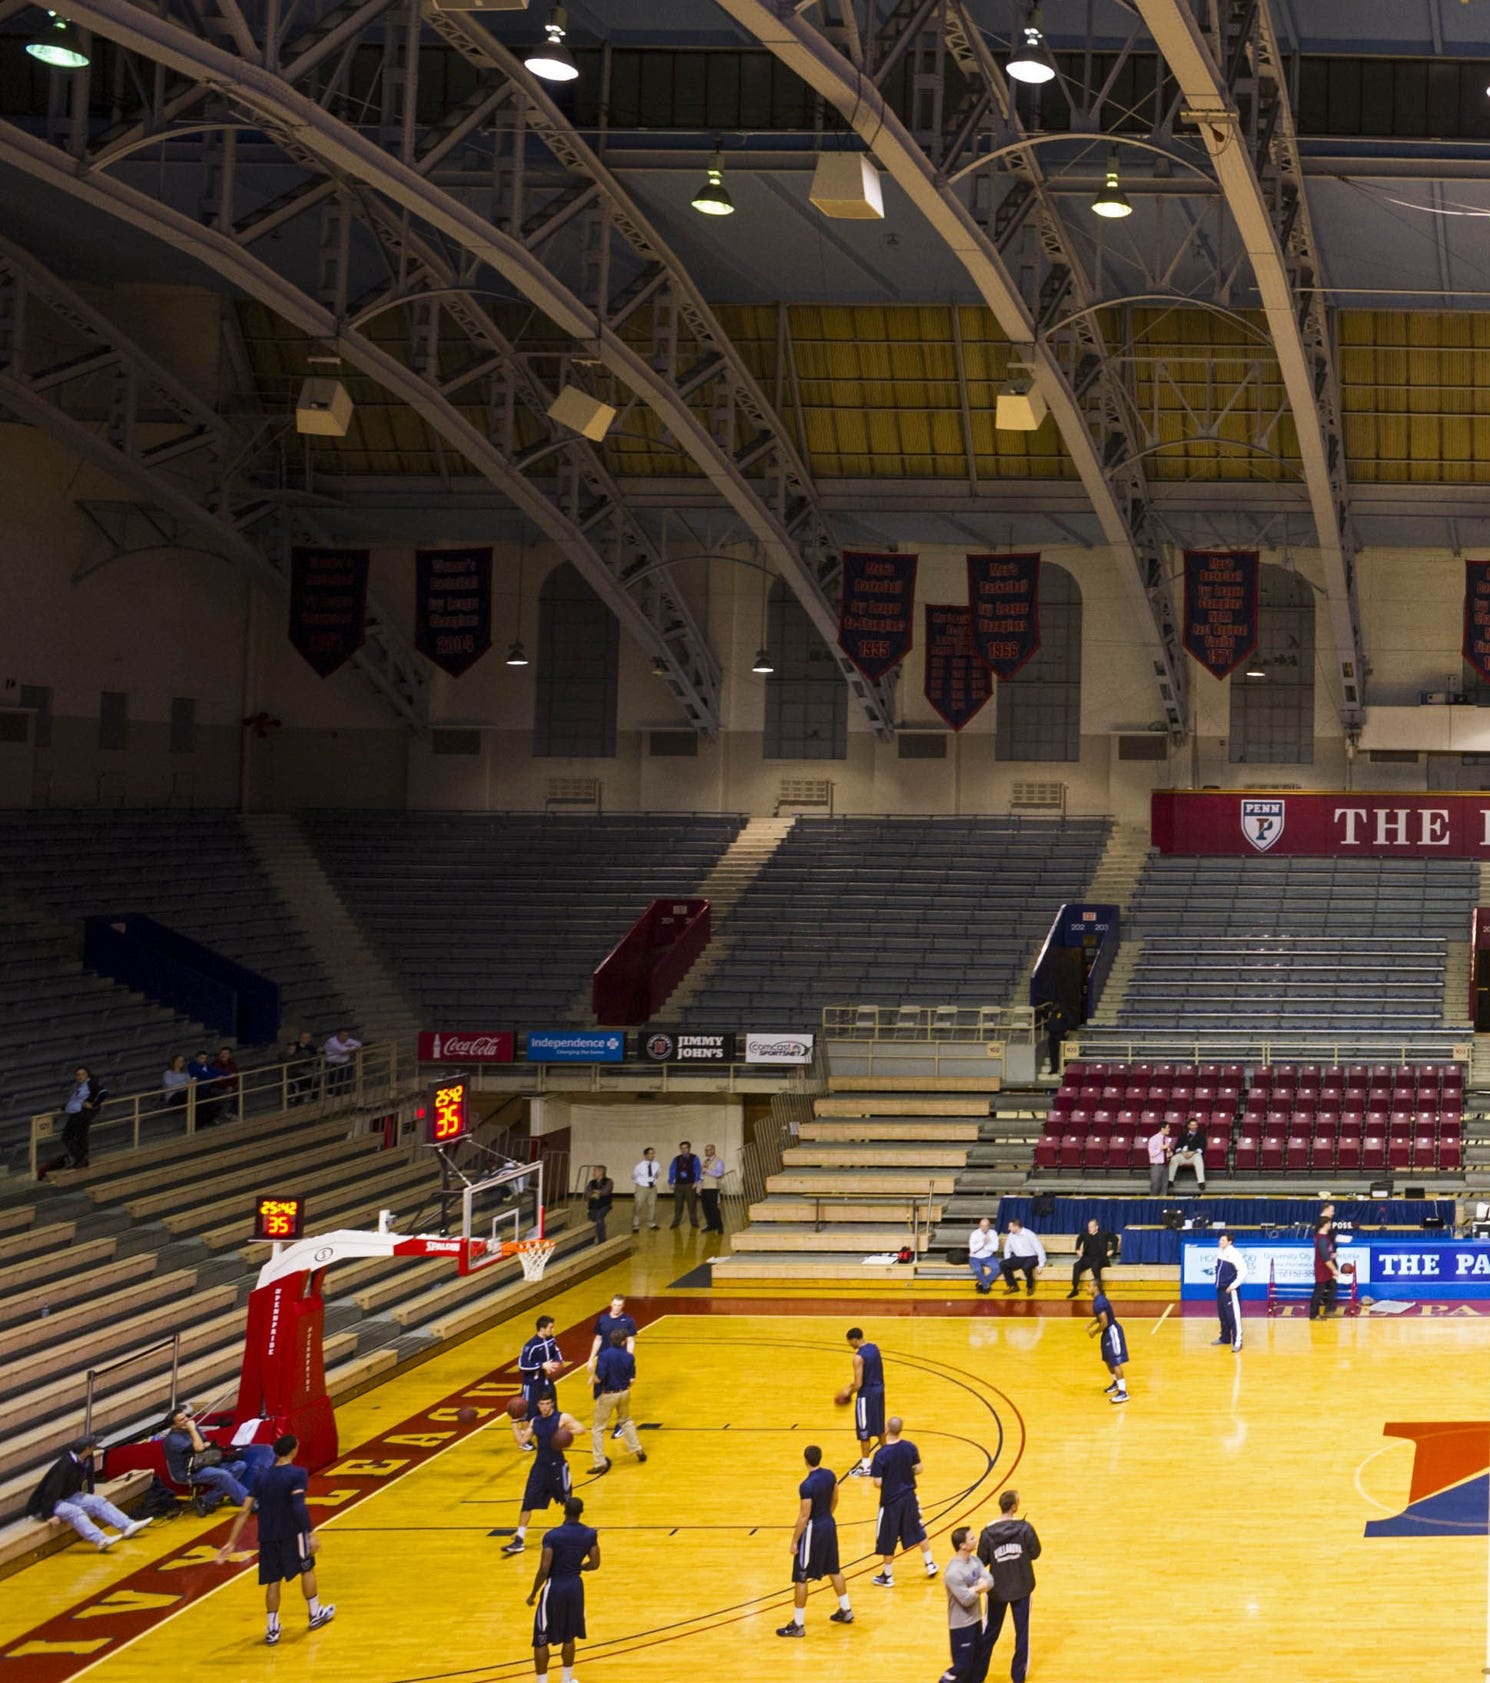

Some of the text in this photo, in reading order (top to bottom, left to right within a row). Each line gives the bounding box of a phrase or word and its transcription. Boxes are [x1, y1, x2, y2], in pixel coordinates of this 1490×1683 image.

[1245, 803, 1281, 814] PENN
[1255, 817, 1273, 841] P
[1333, 808, 1450, 846] THE
[531, 1038, 604, 1050] Independence
[677, 1036, 725, 1046] JIMMY
[676, 1048, 724, 1060] JOHN'S
[434, 1085, 465, 1108] 25:42
[436, 1104, 459, 1138] 35
[260, 1201, 299, 1215] 25:42
[268, 1216, 289, 1233] 35
[1378, 1254, 1440, 1275] THE
[4, 1544, 260, 1659] IVY
